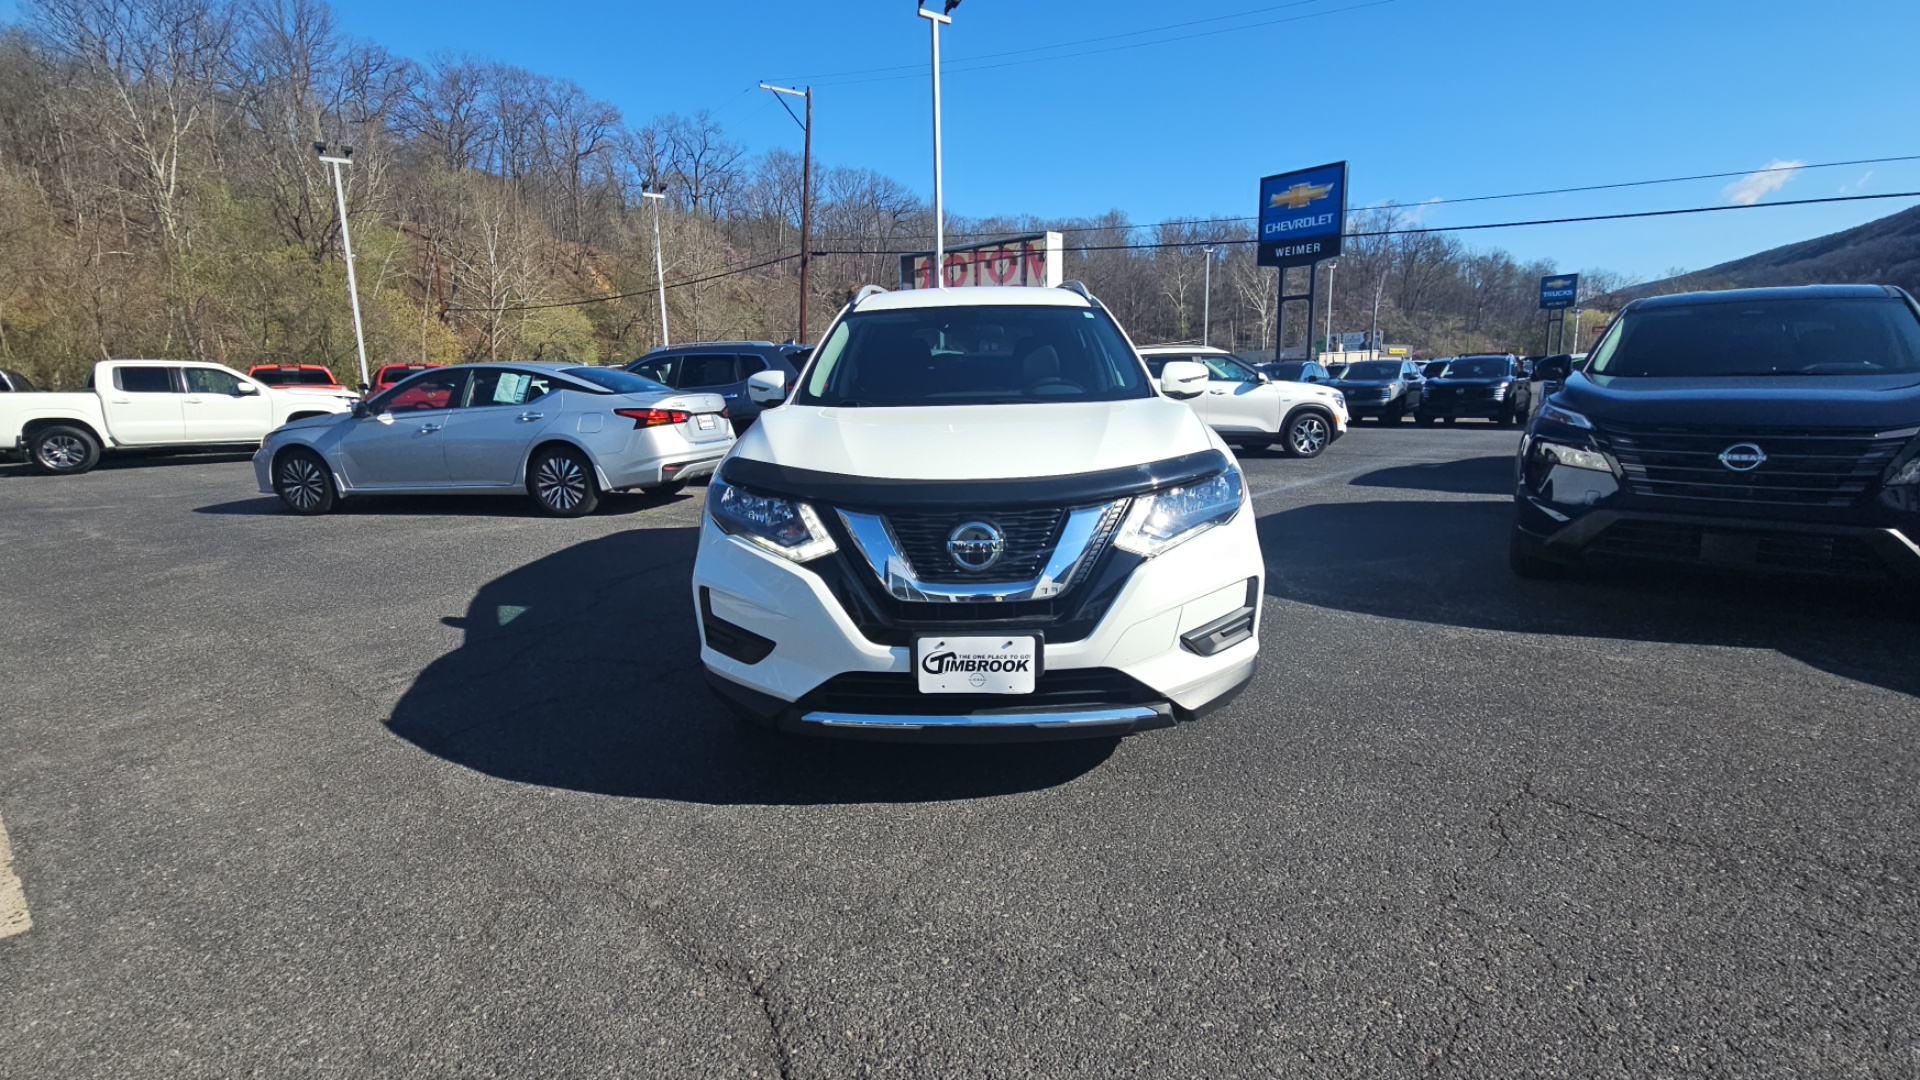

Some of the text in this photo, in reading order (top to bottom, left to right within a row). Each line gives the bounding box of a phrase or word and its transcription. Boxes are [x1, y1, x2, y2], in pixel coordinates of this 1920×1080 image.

[1265, 213, 1334, 234] CHEVROLET
[1275, 242, 1321, 258] WEIMER
[1718, 453, 1767, 461] NISSAN
